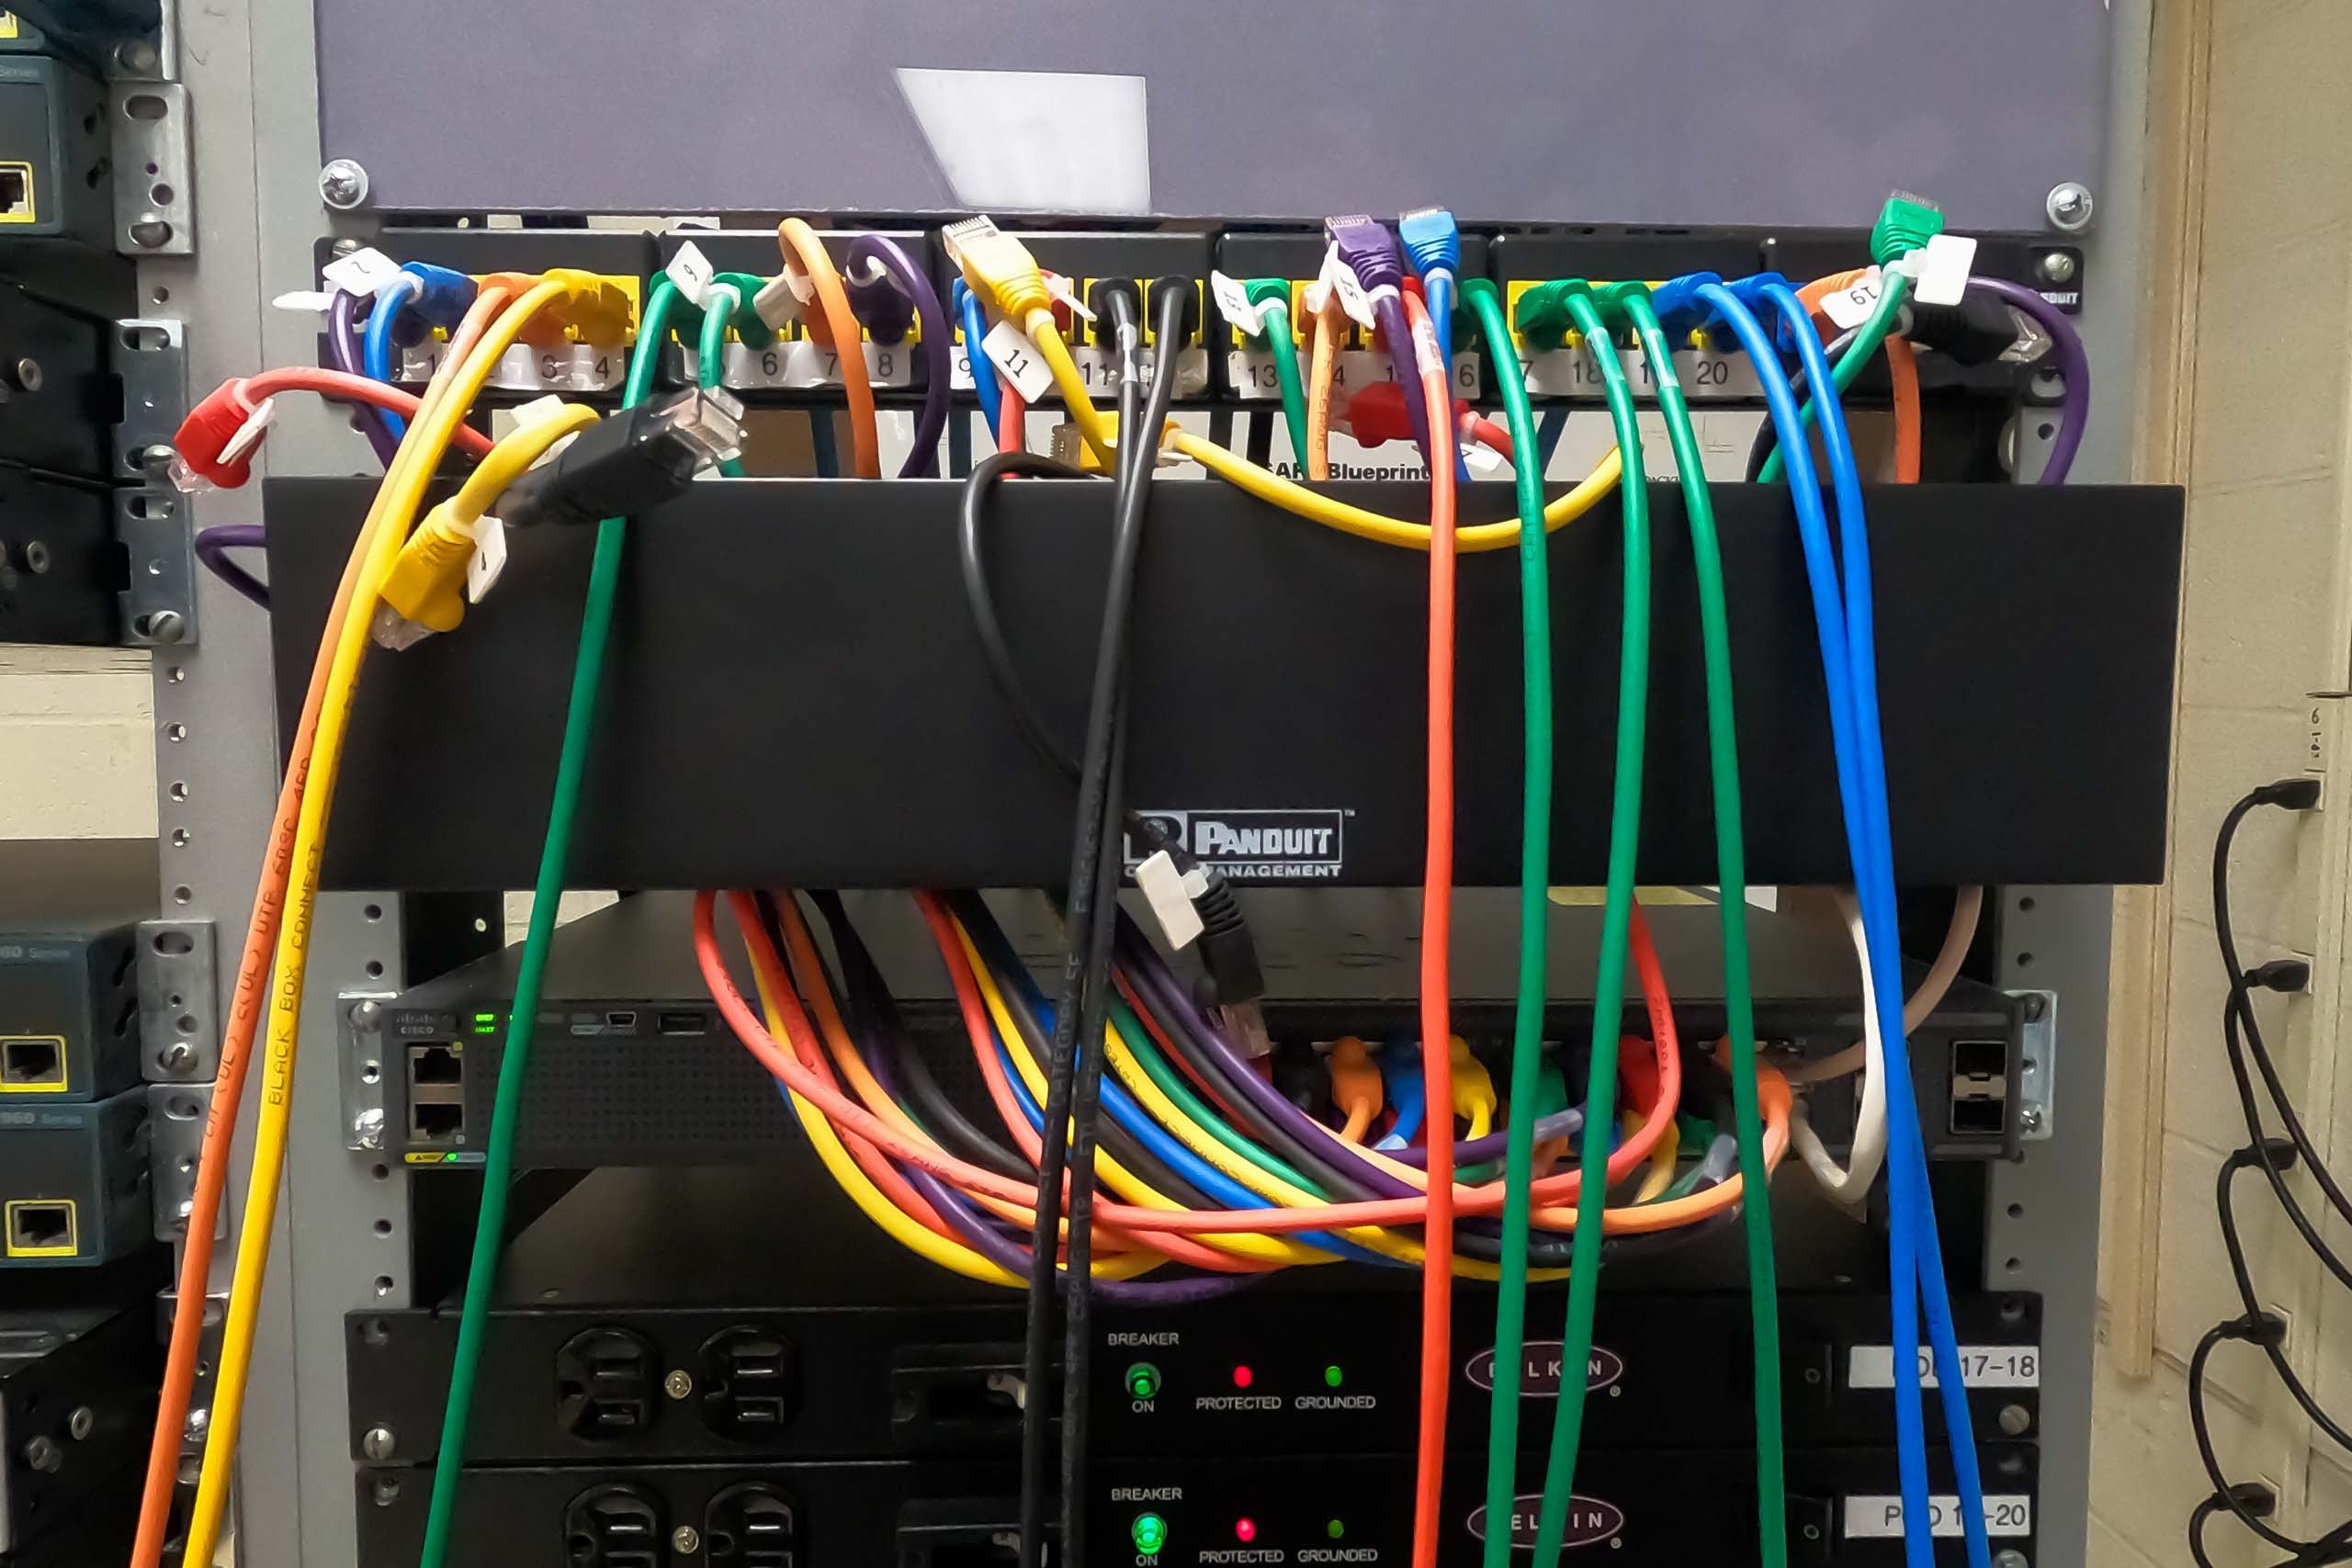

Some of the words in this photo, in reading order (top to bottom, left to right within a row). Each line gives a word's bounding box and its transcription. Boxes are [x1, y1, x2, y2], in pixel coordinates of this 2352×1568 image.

[595, 355, 610, 379] 4
[762, 353, 778, 376] 6
[825, 353, 838, 376] 7
[877, 354, 893, 377] 8
[1003, 347, 1029, 378] 11
[1573, 360, 1600, 384] 18
[1696, 360, 1729, 385] 20
[1248, 364, 1278, 388] 13
[1195, 821, 1332, 855] PANDUIT
[277, 966, 303, 1011] BOX
[266, 1027, 291, 1107] BLACK
[1108, 1332, 1180, 1347] BREAKER
[1131, 1400, 1155, 1414] ON
[1195, 1396, 1283, 1411] PROTECTED
[1295, 1395, 1376, 1410] GROUNDED
[1111, 1487, 1183, 1502] BREAKER
[1136, 1553, 1159, 1567] ON
[1199, 1550, 1285, 1563] PROTECTED
[1297, 1549, 1378, 1562] GROUNDED
